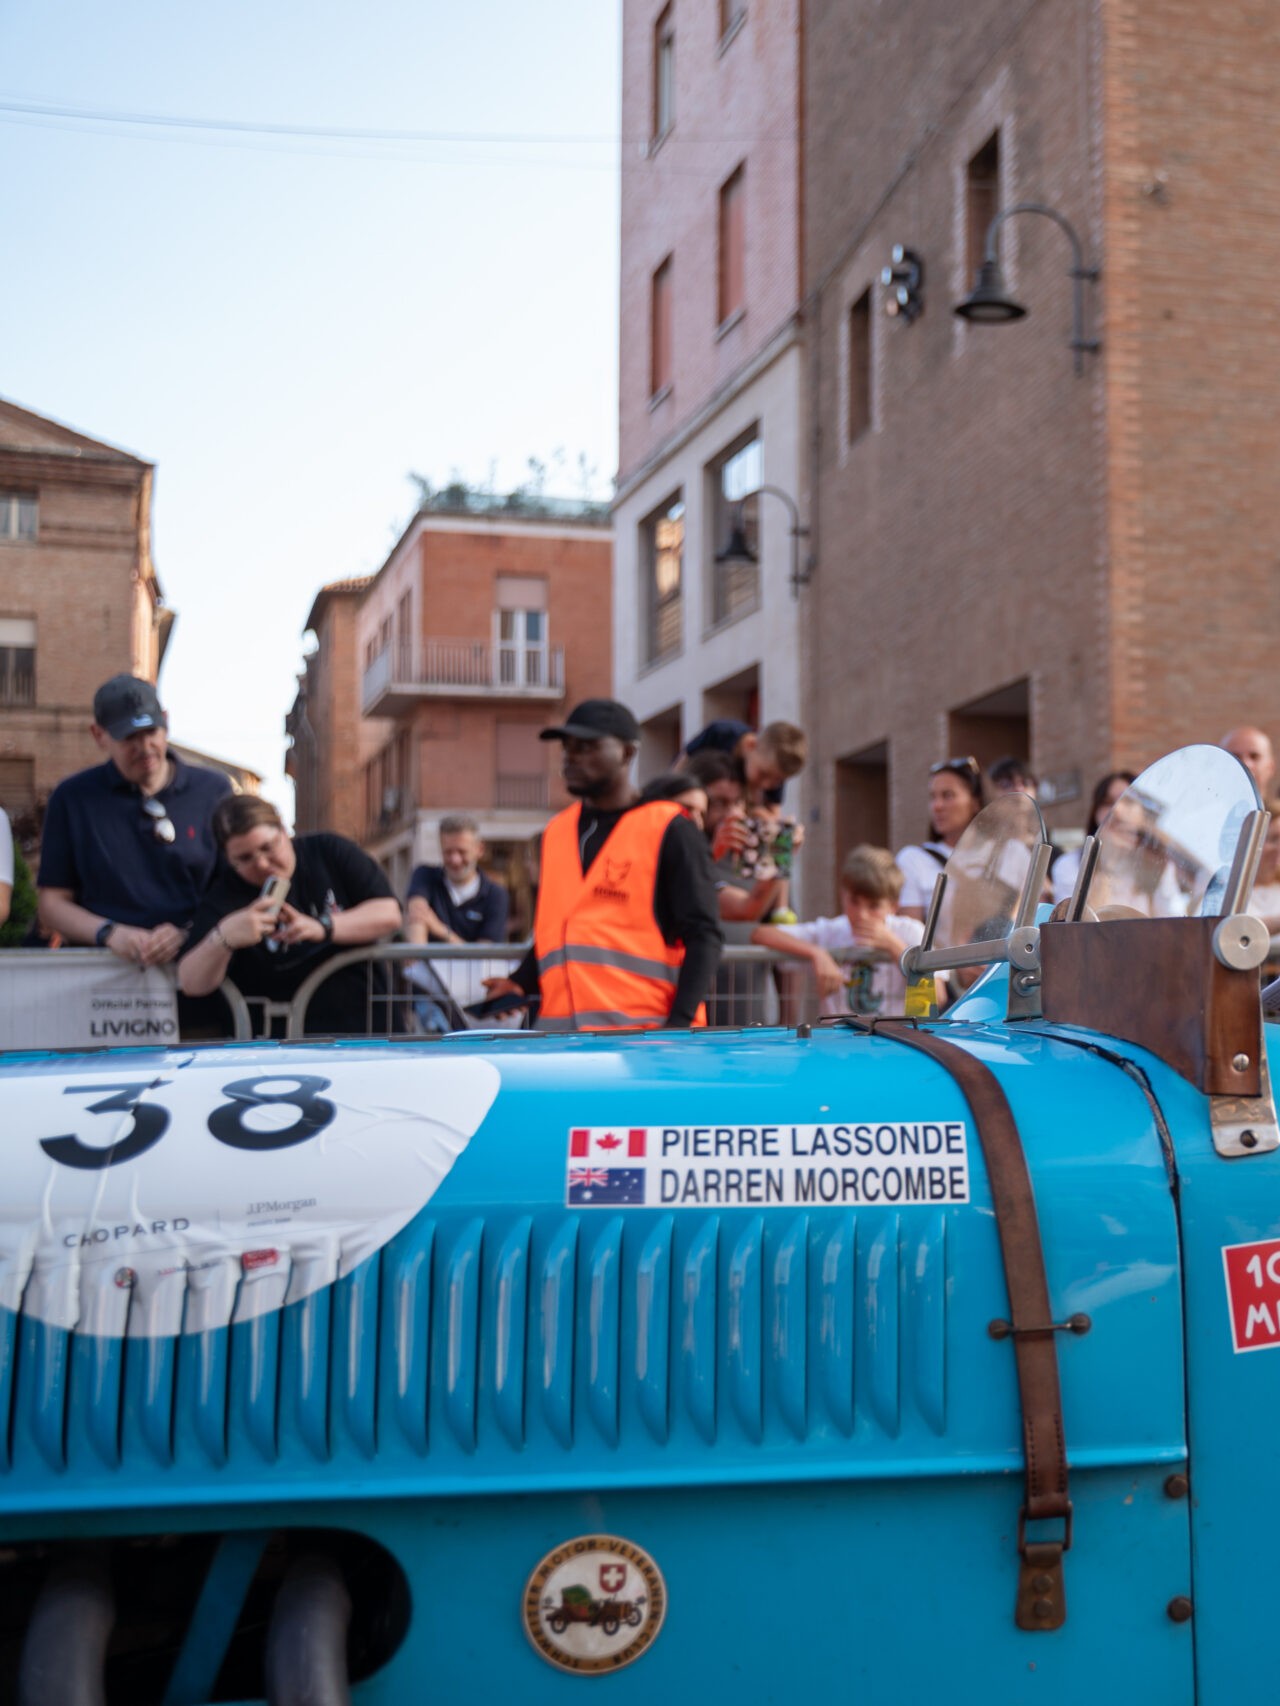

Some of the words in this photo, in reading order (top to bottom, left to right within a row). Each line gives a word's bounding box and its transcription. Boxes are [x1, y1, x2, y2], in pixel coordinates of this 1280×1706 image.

[90, 1018, 176, 1038] LIVIGNO
[39, 1074, 337, 1170] 38
[661, 1127, 779, 1157] PIERRE
[791, 1124, 964, 1157] LASSONDE
[660, 1168, 784, 1203] DARREN
[798, 1166, 966, 1202] MORCOMBE
[63, 1217, 191, 1248] CHOPARD
